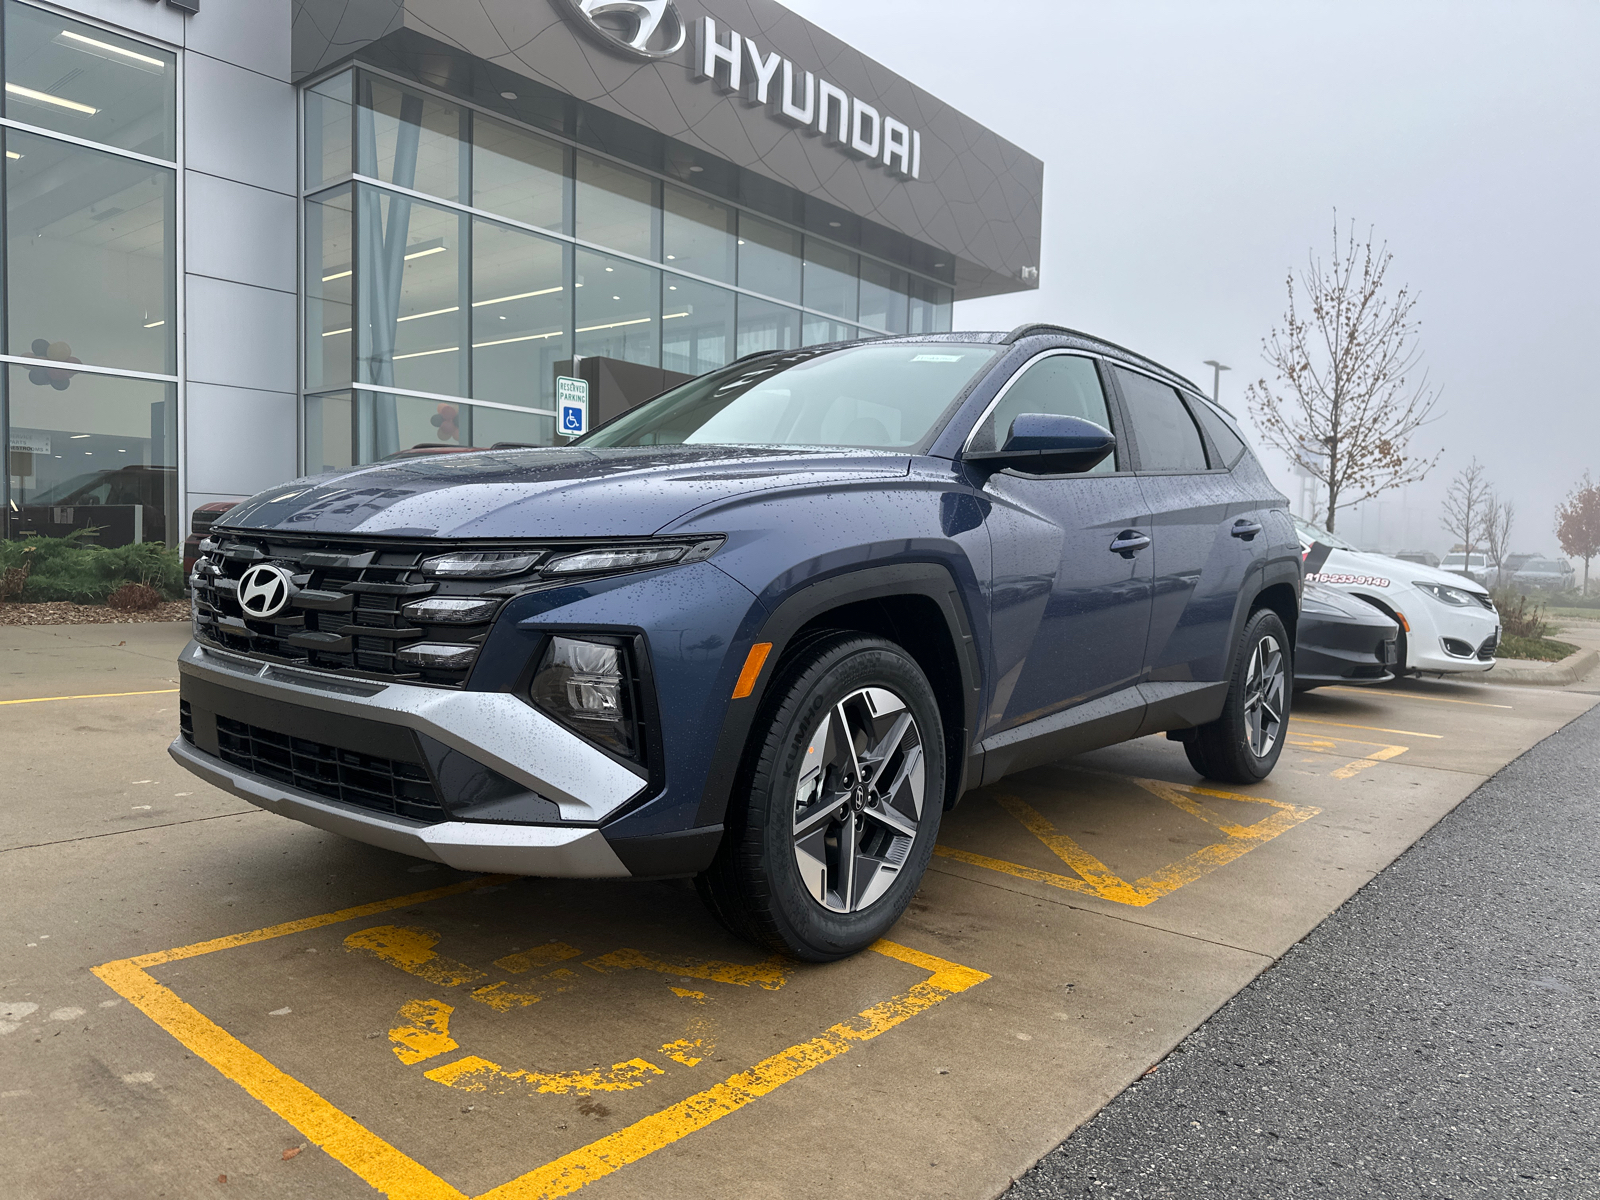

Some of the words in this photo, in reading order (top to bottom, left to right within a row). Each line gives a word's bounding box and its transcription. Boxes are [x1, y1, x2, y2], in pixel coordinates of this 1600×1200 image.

[697, 15, 921, 180] HYUNDAI
[560, 382, 586, 394] RESERVED
[560, 392, 586, 404] PARKING
[782, 694, 824, 778] KUMHO
